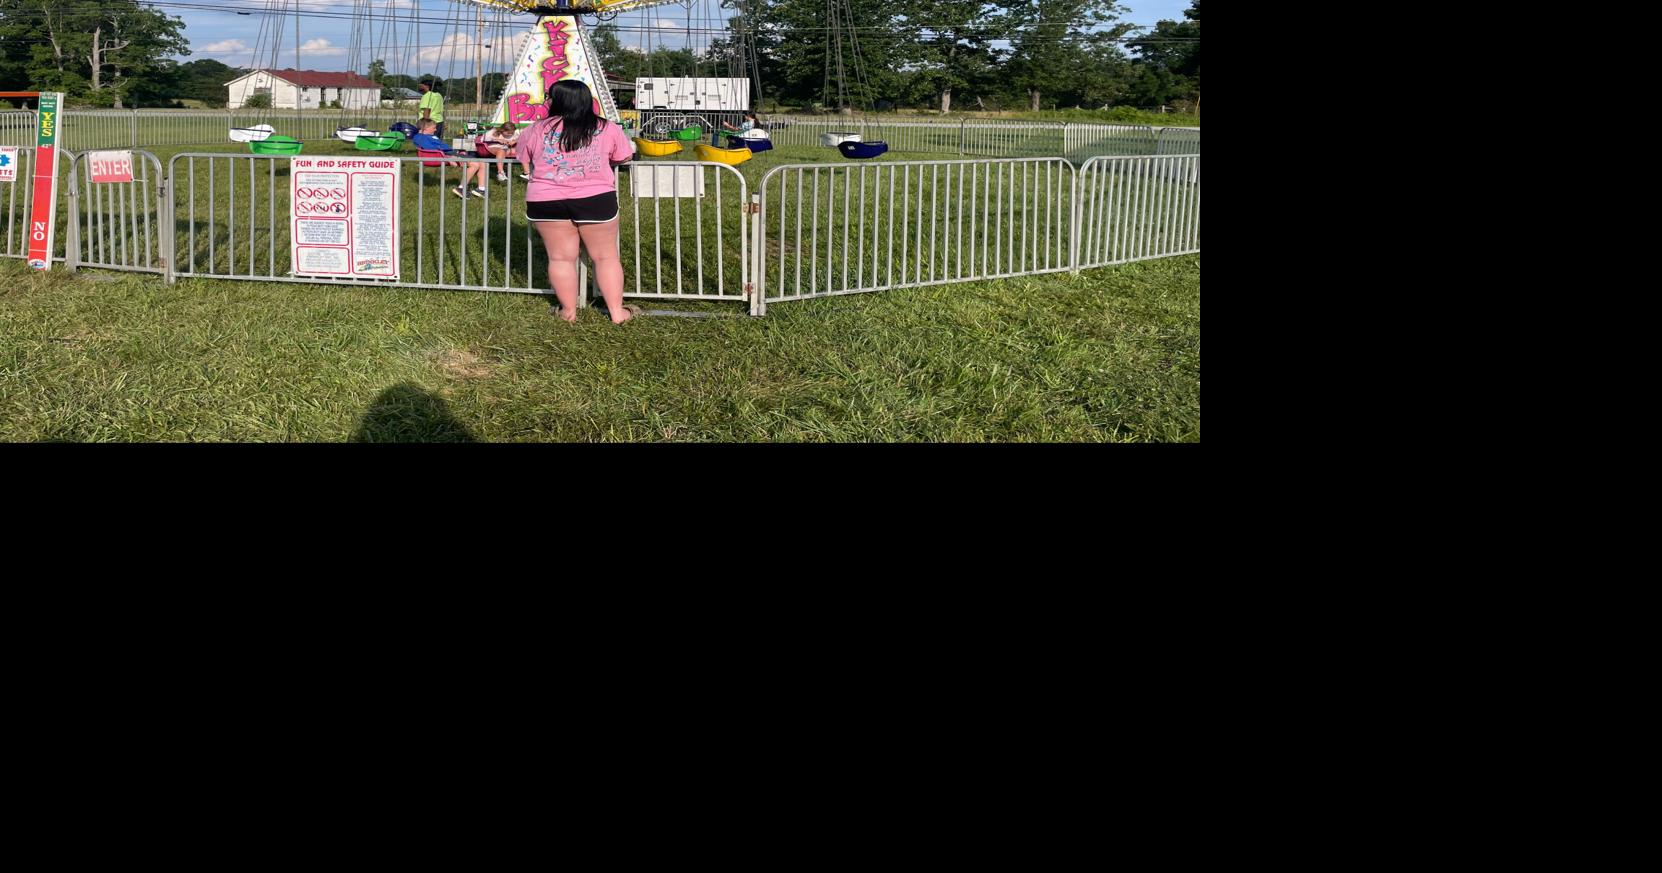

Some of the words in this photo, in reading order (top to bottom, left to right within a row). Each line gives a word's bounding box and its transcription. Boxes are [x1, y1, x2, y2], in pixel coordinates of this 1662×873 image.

[41, 112, 54, 137] YES
[91, 159, 132, 176] ENTER
[296, 160, 312, 168] FUN
[316, 160, 335, 168] AND
[337, 160, 366, 169] SAFETY
[368, 161, 395, 169] GUIDE
[33, 221, 46, 241] NO
